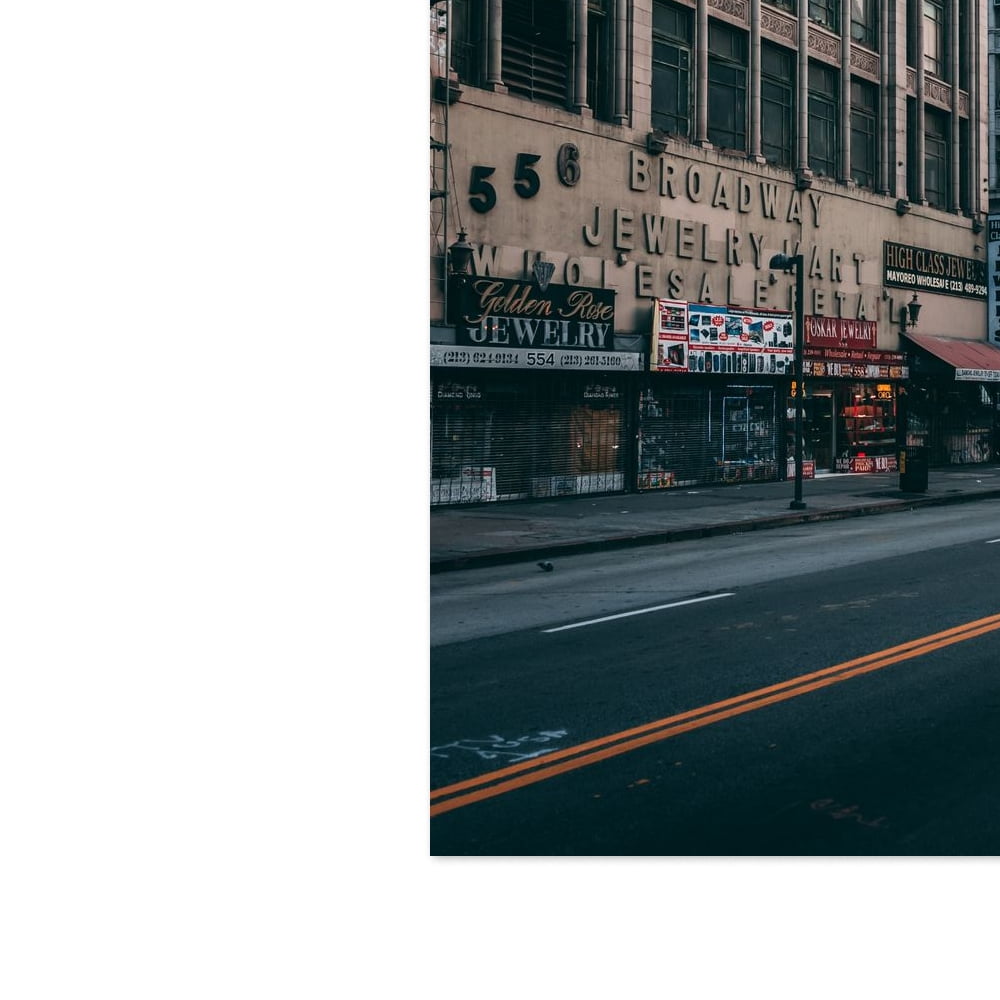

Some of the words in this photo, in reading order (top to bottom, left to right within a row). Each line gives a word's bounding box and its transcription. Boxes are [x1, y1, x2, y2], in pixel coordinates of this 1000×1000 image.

[468, 142, 581, 213] 556
[629, 149, 824, 227] BROADWAY
[583, 206, 768, 270] JEWELRY
[886, 243, 913, 271] HIGH
[915, 250, 944, 276] CLASS
[886, 269, 916, 284] MAYOREO
[465, 279, 552, 324] Golden
[557, 290, 614, 320] Rose
[467, 315, 611, 348] JEWELRY
[810, 319, 838, 338] OSKAR
[840, 321, 873, 341] JEWELRY
[443, 351, 470, 364] (213)
[526, 353, 555, 366] 554
[560, 355, 583, 367] (213)
